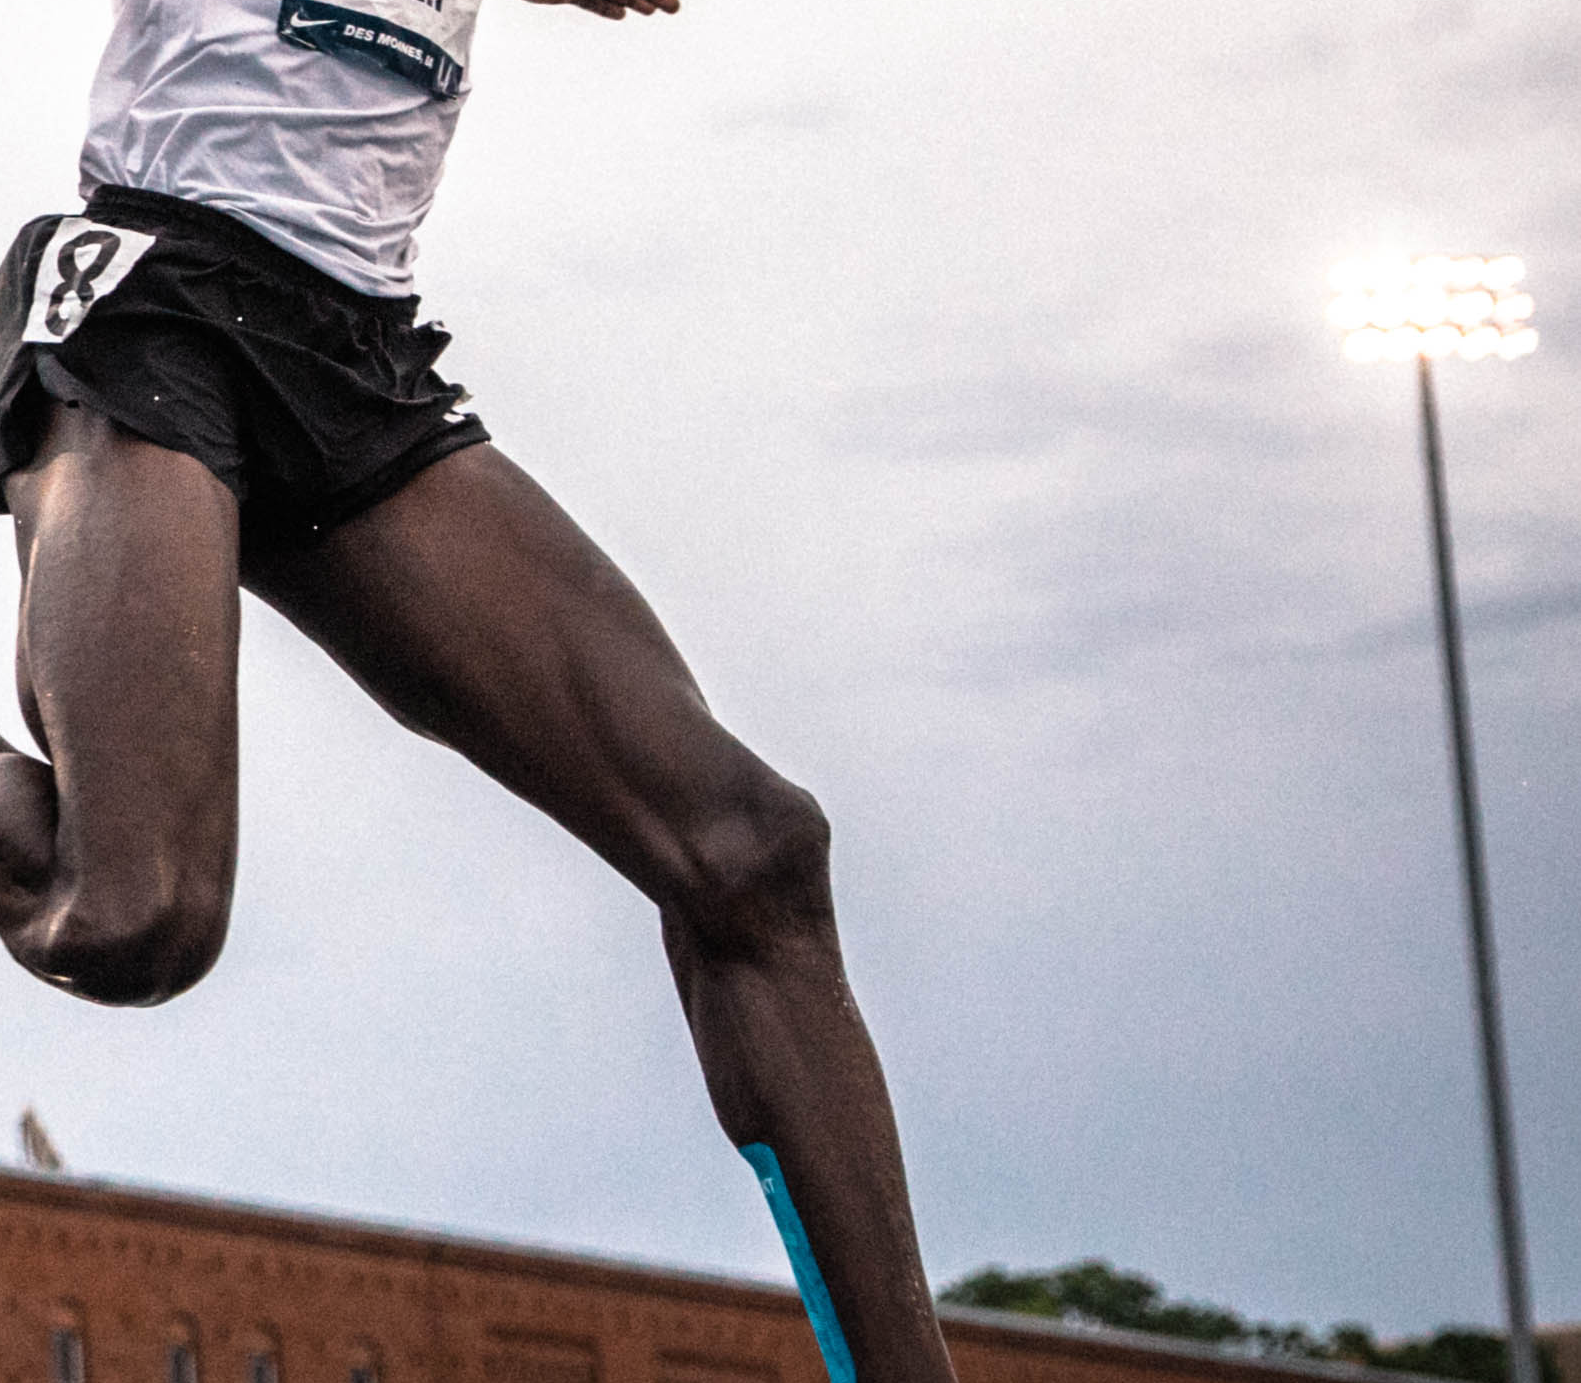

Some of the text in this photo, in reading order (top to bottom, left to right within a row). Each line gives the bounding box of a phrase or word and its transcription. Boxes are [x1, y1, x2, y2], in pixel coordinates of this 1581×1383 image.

[343, 24, 375, 41] DES
[376, 33, 423, 64] MOINES,
[45, 230, 121, 336] 8
